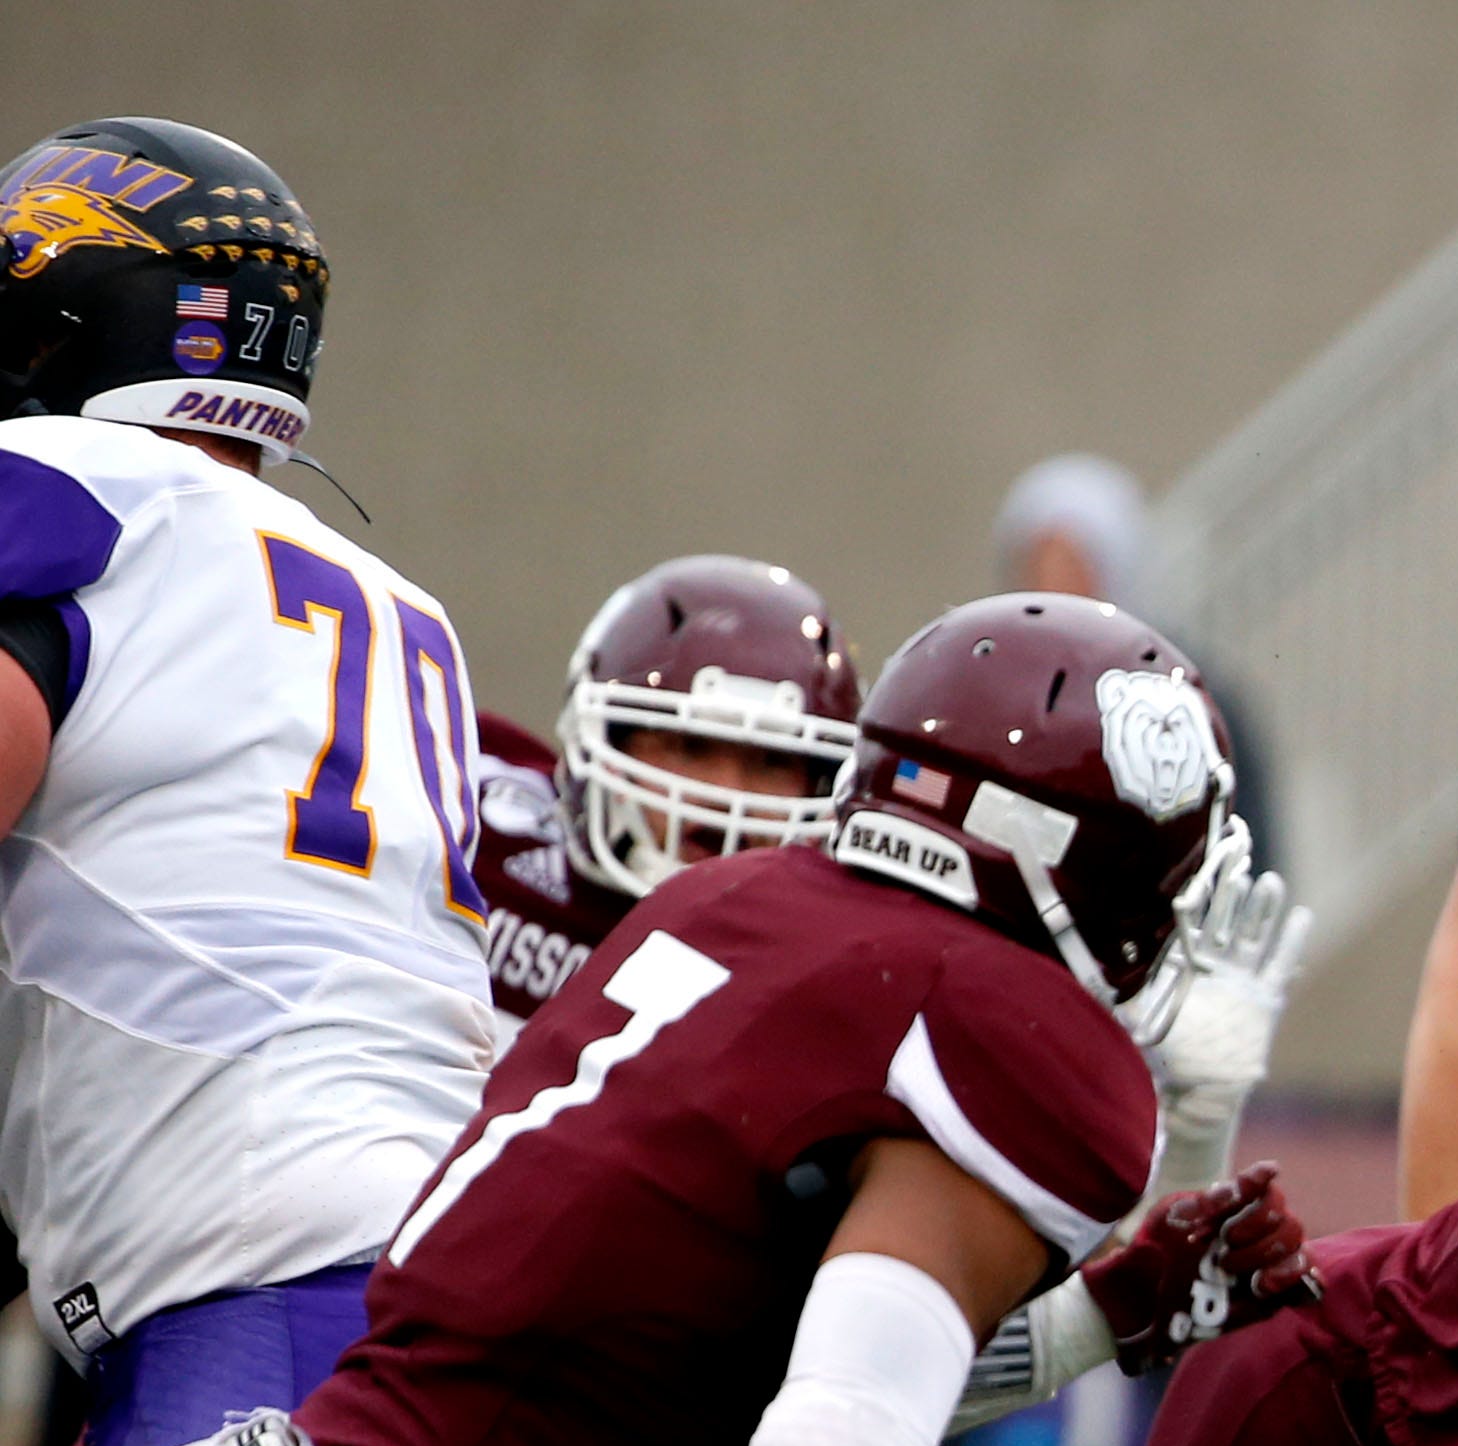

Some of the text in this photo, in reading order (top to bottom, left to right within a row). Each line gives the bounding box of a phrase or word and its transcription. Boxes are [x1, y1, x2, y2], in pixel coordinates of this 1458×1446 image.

[5, 146, 196, 213] UNI
[239, 303, 310, 372] 70
[254, 529, 489, 928] 70
[850, 825, 958, 877] BEAR UP
[387, 928, 733, 1269] 7
[61, 1293, 95, 1324] 2XL
